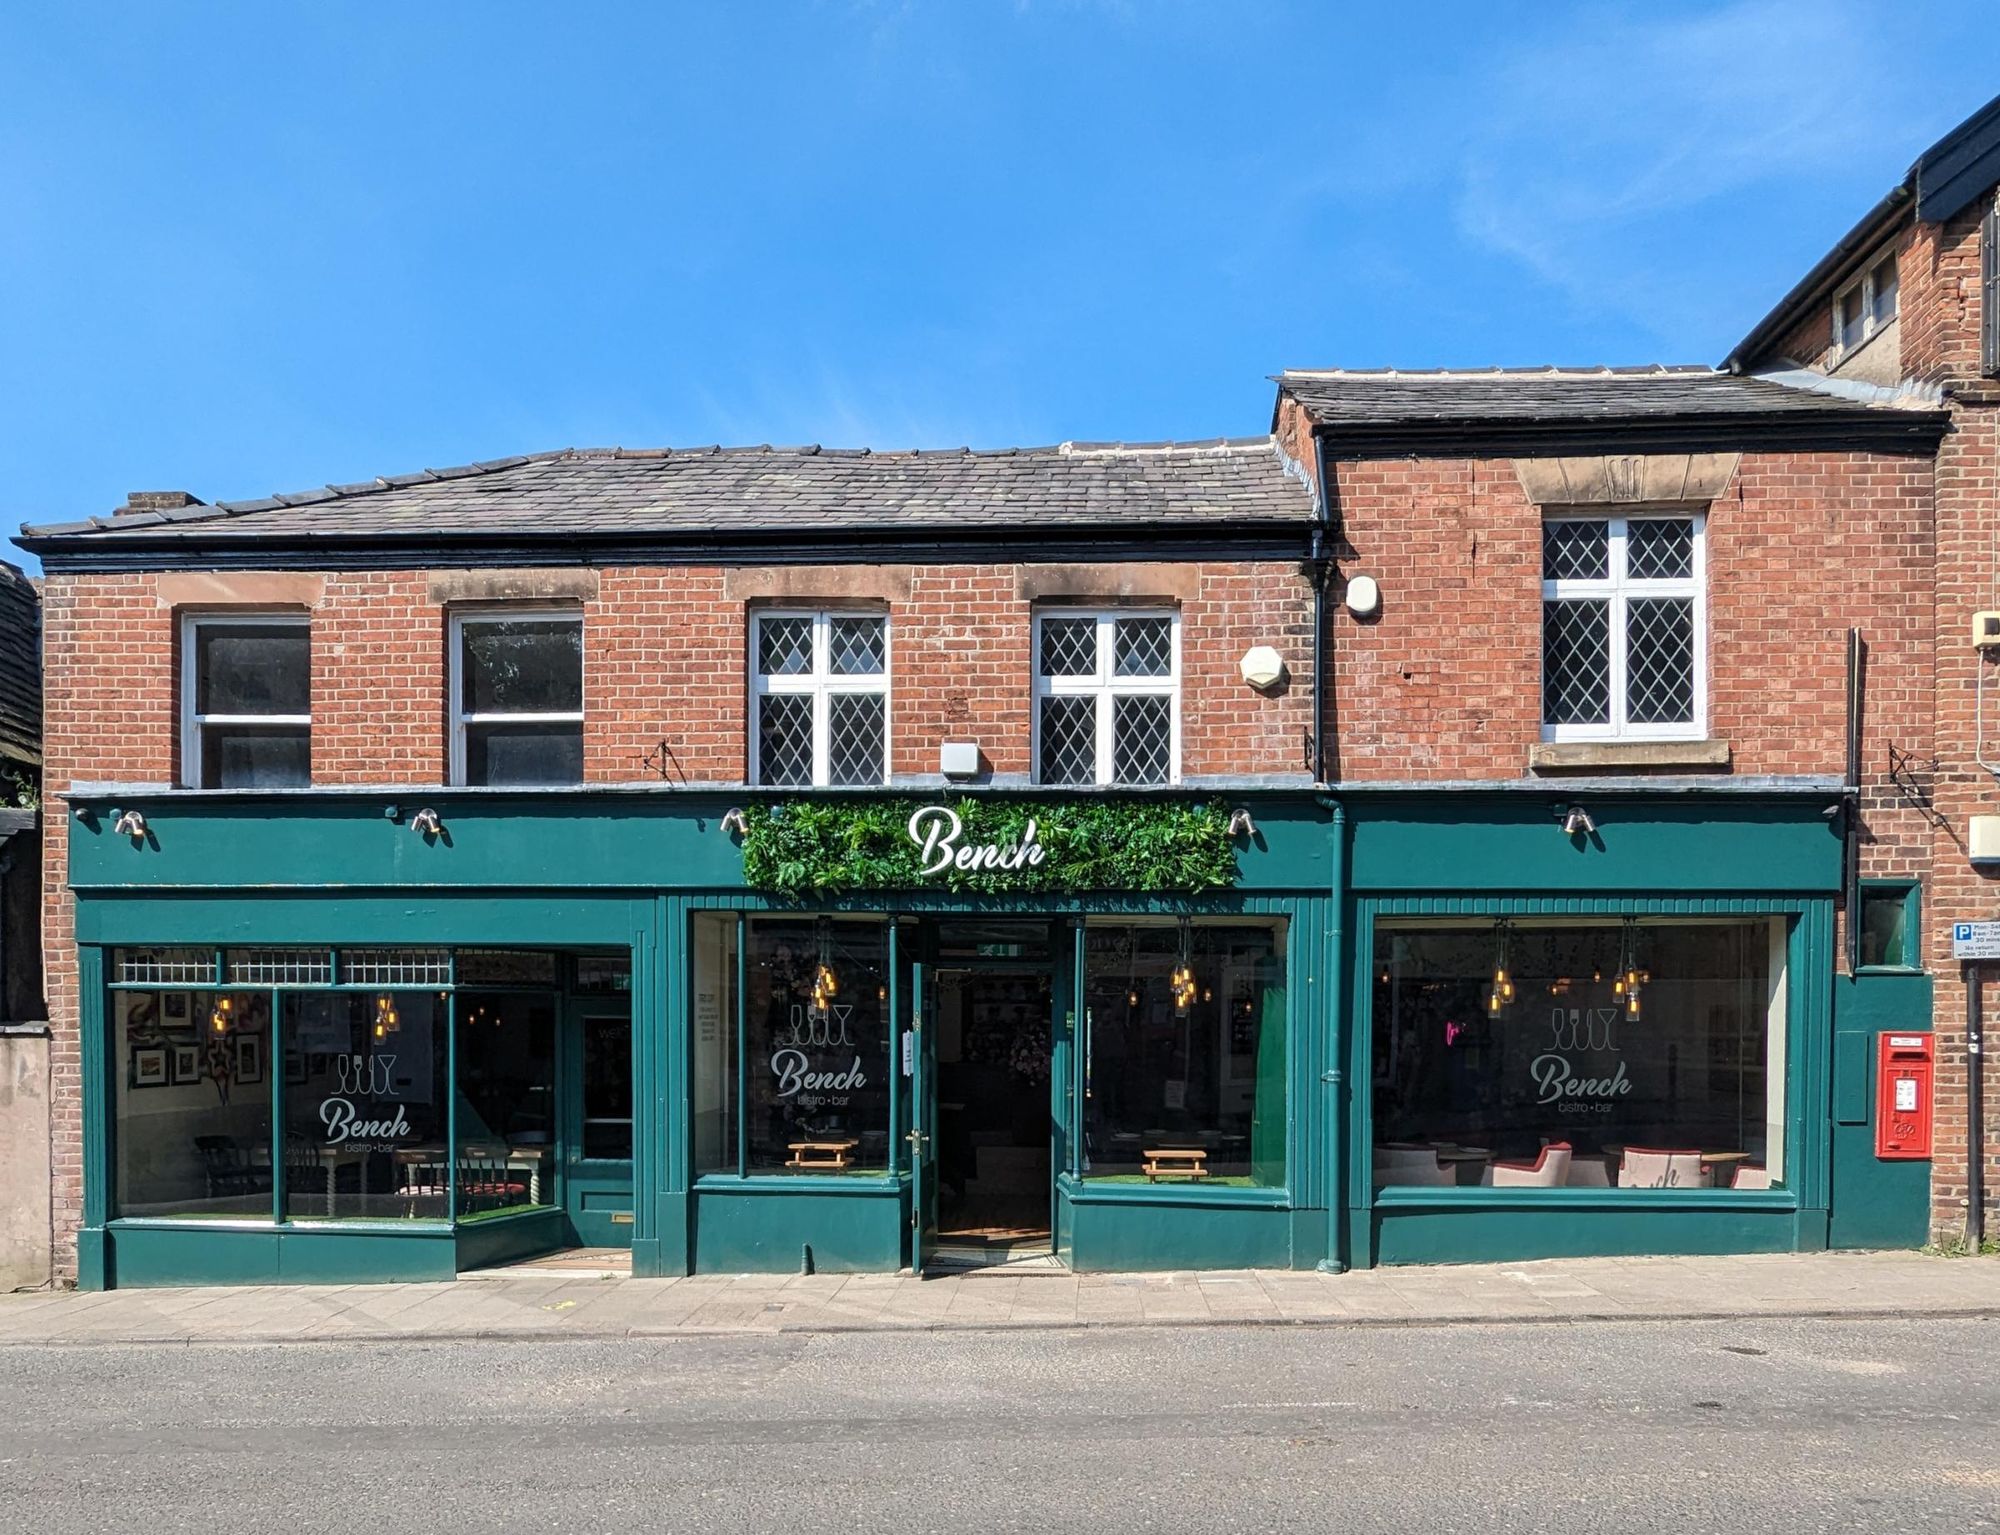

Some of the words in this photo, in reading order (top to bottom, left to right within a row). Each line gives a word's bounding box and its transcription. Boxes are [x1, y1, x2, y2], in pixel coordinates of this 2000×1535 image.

[908, 806, 1046, 875] Bench
[771, 1049, 867, 1097] Bench
[1530, 1054, 1633, 1105] Bench
[319, 1097, 411, 1145] Bench
[797, 1095, 826, 1106] bistro
[832, 1095, 850, 1106] bar
[1558, 1101, 1588, 1113] bistro
[1595, 1101, 1613, 1113] bar
[344, 1141, 372, 1153] bistro
[377, 1141, 394, 1153] bar
